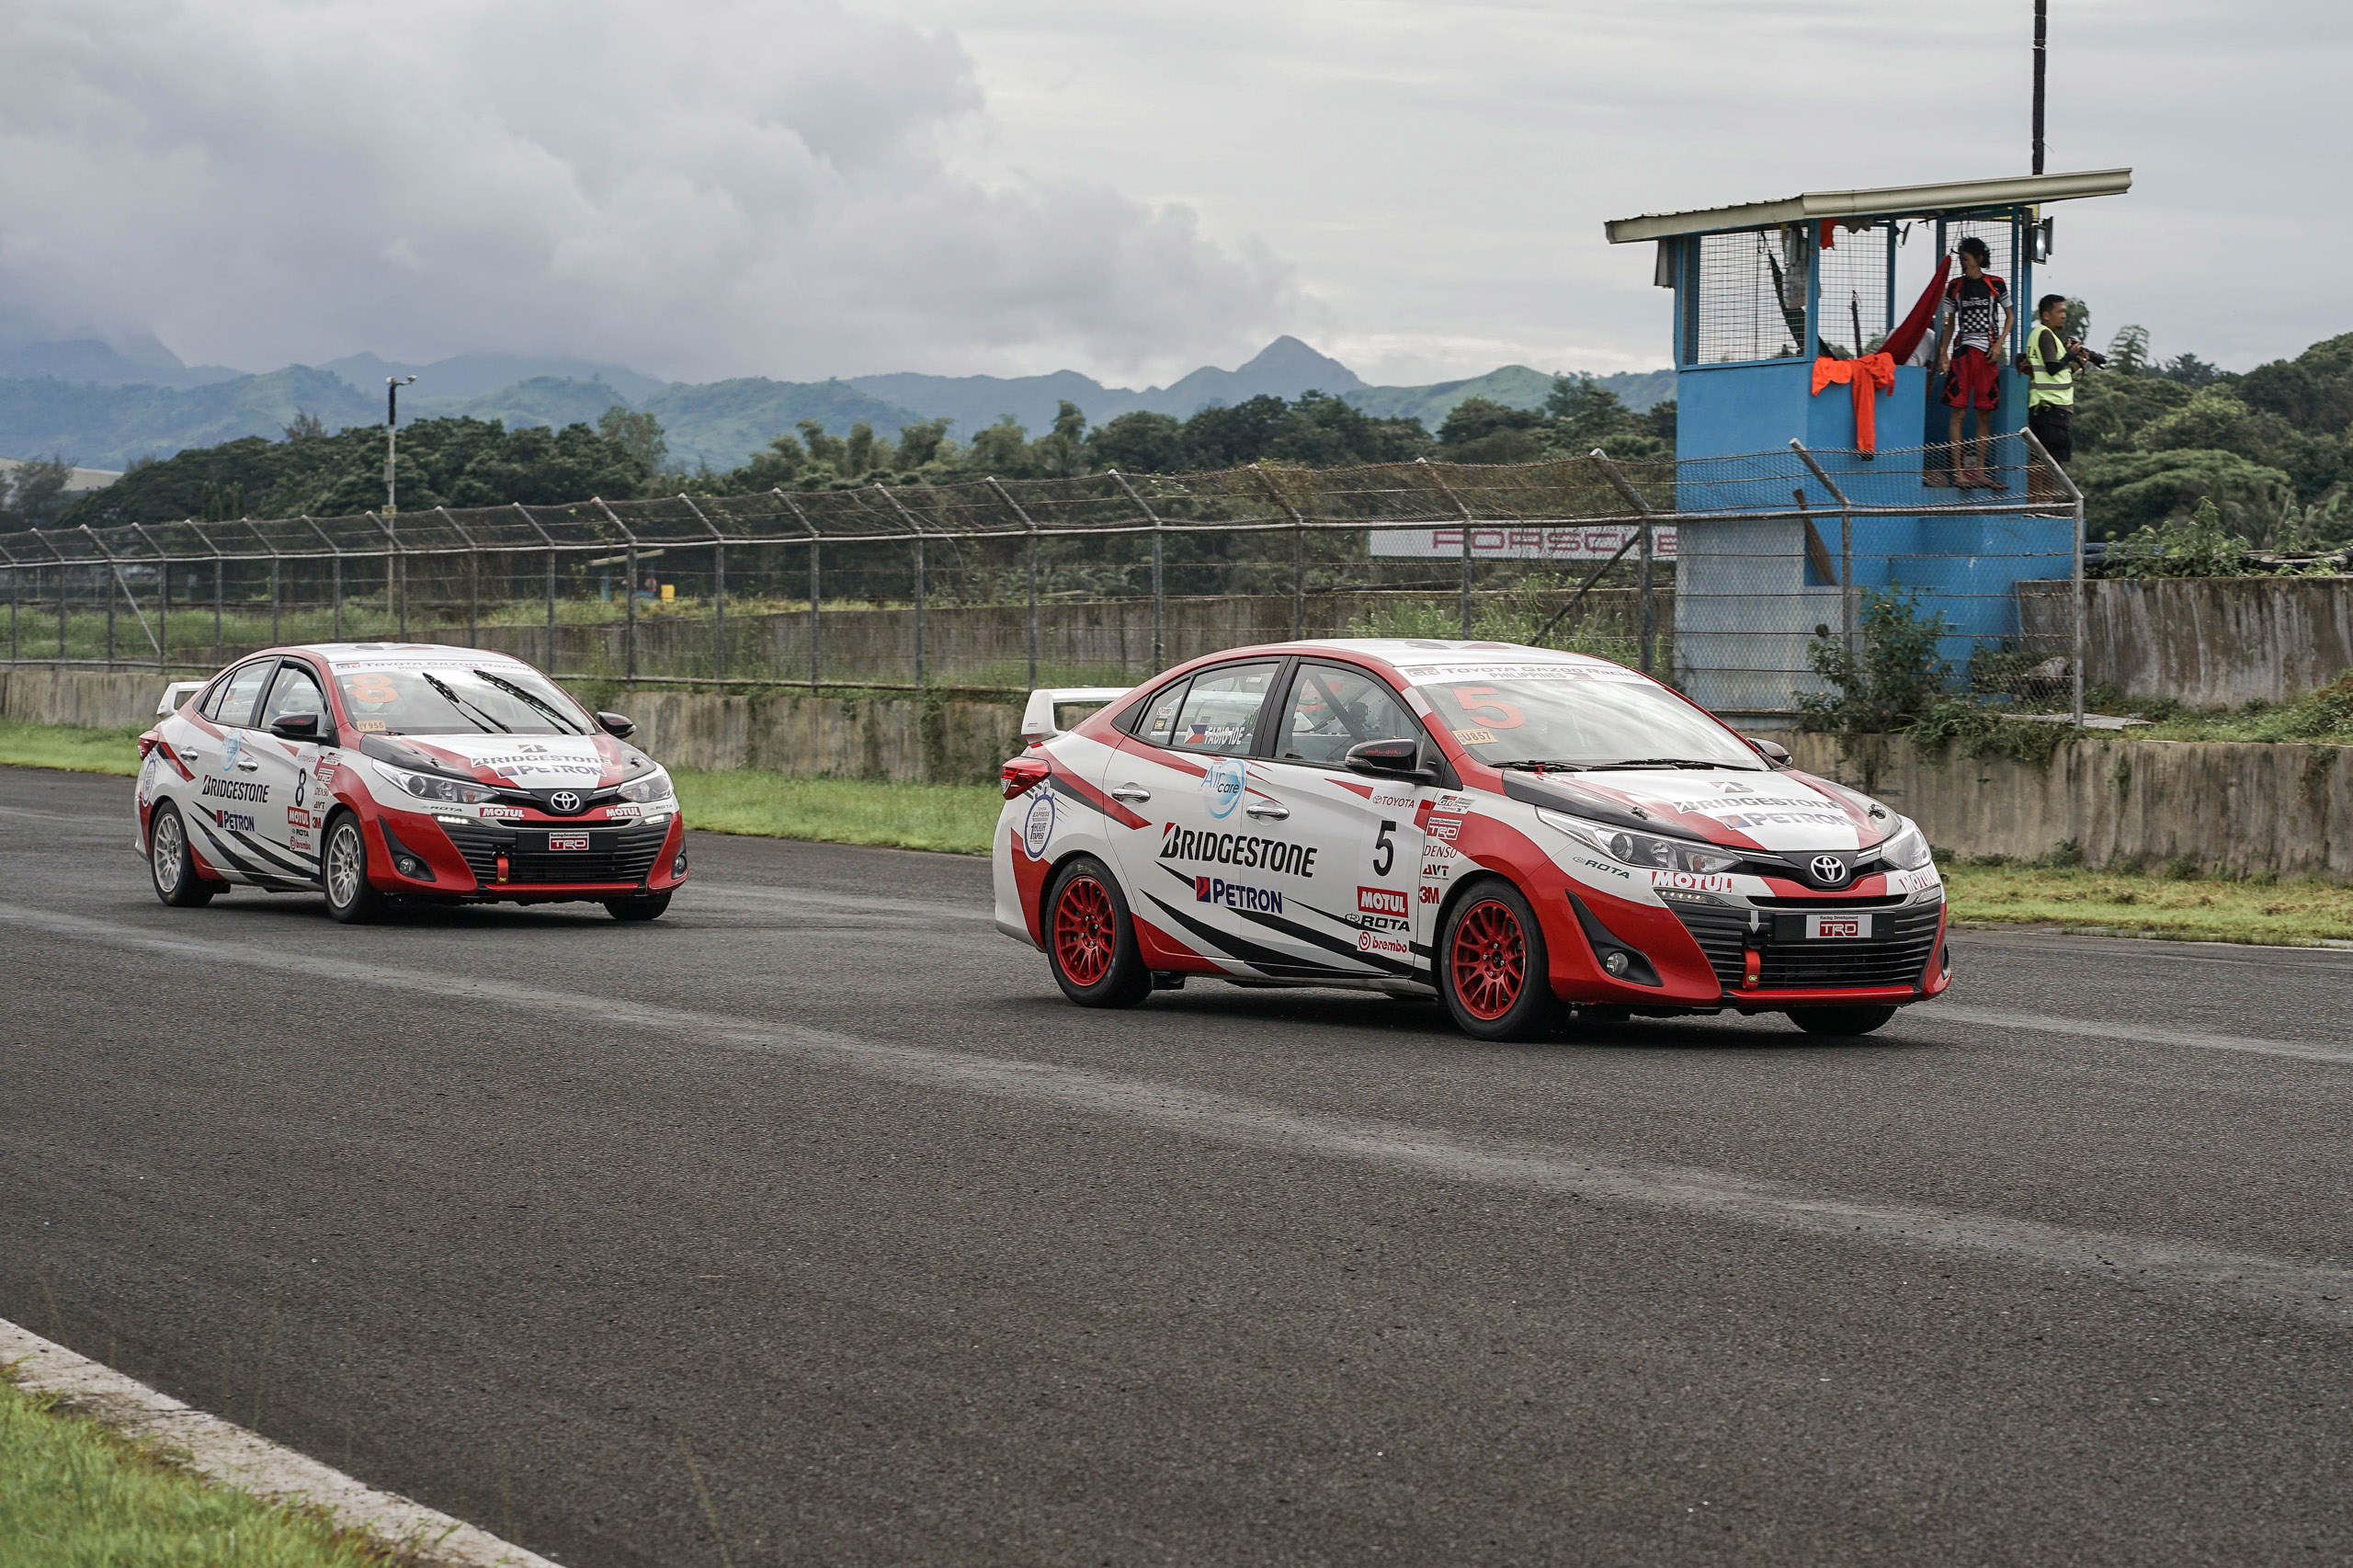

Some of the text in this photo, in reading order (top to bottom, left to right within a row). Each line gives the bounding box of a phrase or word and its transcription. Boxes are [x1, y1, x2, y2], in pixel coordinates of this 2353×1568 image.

[1489, 671, 1566, 679] PHILIPPINES
[1585, 668, 1644, 680] Racing
[352, 673, 398, 703] 8
[1451, 687, 1526, 729] 5
[472, 755, 612, 766] BRIDGESTONE
[1200, 765, 1226, 788] Air
[202, 775, 270, 803] BRIDGESTONE
[295, 767, 307, 807] 8
[1217, 782, 1240, 793] care
[1381, 796, 1415, 809] TOYOTA
[1674, 797, 1848, 812] BRIDGESTONE
[289, 809, 310, 826] MOTUL
[482, 808, 525, 817] MOTUL
[606, 806, 641, 817] MOTUL
[1743, 812, 1855, 826] PETRON
[224, 810, 255, 832] PETRON
[312, 816, 322, 829] 3M
[1428, 825, 1458, 838] TRD
[551, 839, 586, 849] TRD
[1159, 823, 1317, 878] BRIDGESTONE
[1373, 820, 1396, 877] 5
[1424, 845, 1458, 858] DENSO
[1422, 864, 1449, 876] AVT
[1585, 859, 1631, 880] ROTA
[1653, 871, 1733, 892] MOTUL
[1212, 878, 1283, 915] PETRON
[1360, 891, 1406, 914] MOTUL
[1419, 886, 1440, 904] 3M
[1360, 915, 1411, 932] ROTA
[1820, 923, 1858, 937] TRD
[1372, 936, 1407, 953] brembo
